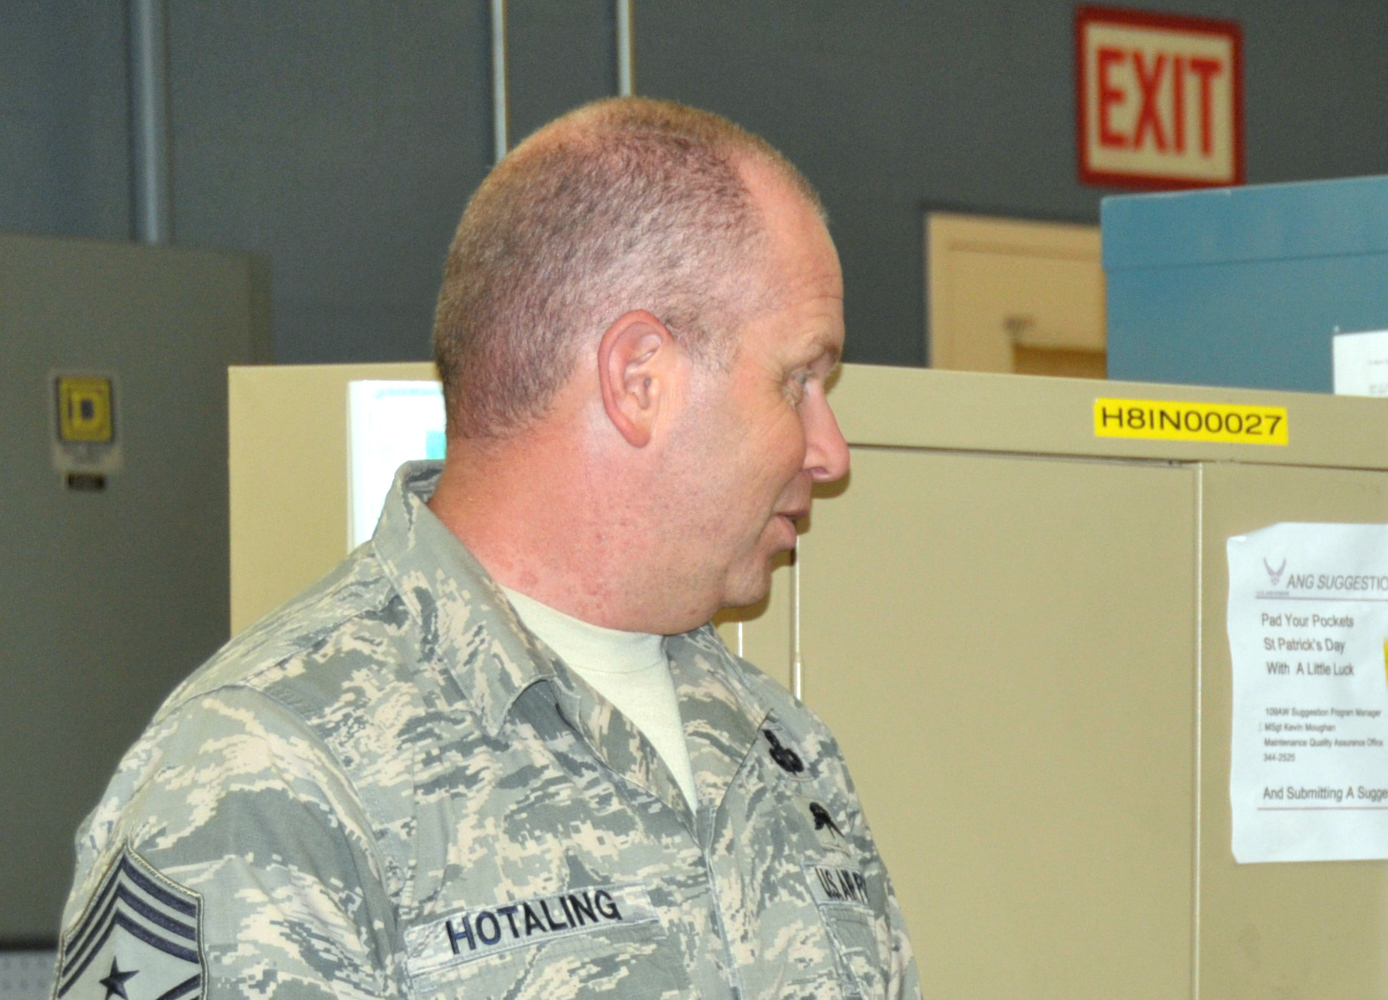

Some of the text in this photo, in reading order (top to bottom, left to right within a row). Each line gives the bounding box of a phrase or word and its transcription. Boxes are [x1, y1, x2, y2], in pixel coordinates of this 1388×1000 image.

[1097, 48, 1223, 157] EXIT
[1101, 406, 1283, 436] H8IN00027
[1286, 573, 1315, 590] ANG
[1261, 612, 1355, 628] Pad Your Pockets
[1263, 636, 1346, 655] St Patrick's Day
[1266, 661, 1355, 676] With A Little Luck
[1291, 707, 1329, 719] Suggestion
[1330, 707, 1354, 718] Program
[1355, 708, 1382, 718] Manager
[1284, 723, 1303, 732] Kevin
[1264, 738, 1384, 748] Maintenance Quality Assurance Office
[1263, 786, 1284, 800] And
[1286, 786, 1343, 803] Submitting
[1346, 786, 1355, 800] A
[445, 889, 623, 955] HOTALING
